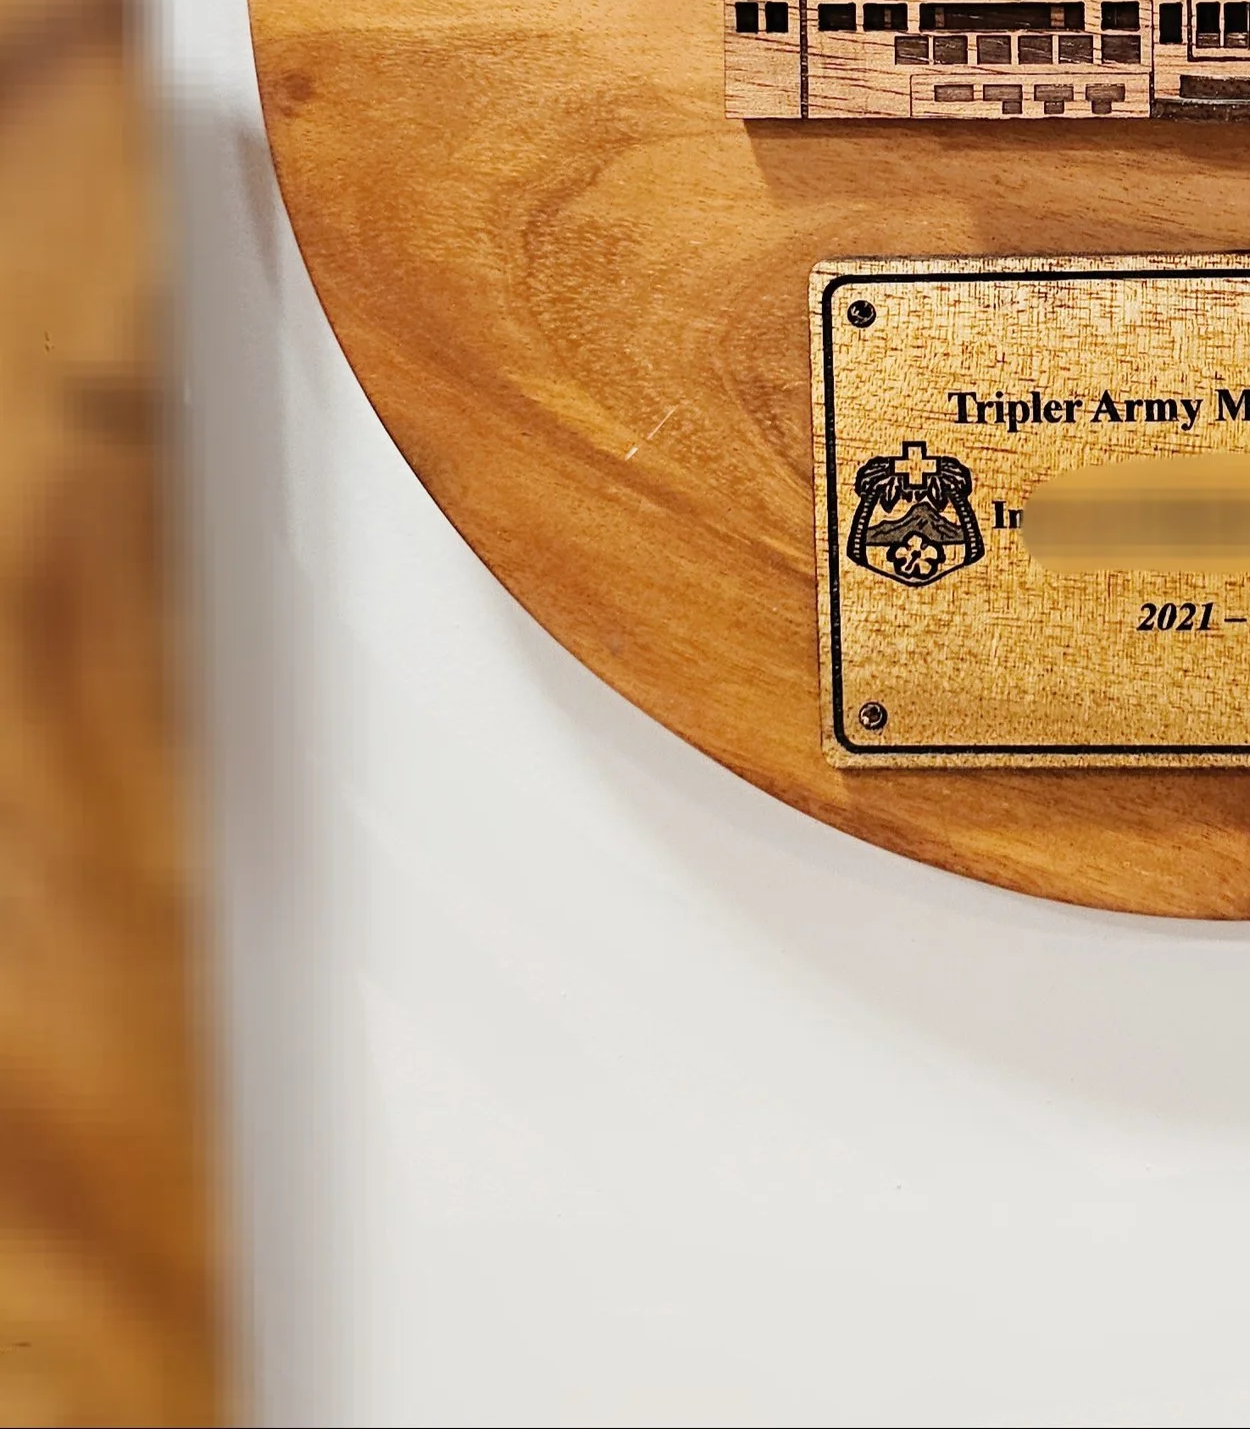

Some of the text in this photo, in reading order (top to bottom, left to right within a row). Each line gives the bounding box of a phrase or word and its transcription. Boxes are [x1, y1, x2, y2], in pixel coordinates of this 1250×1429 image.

[947, 390, 1083, 433] Tripler
[1091, 388, 1203, 431] Army
[1136, 601, 1214, 631] 2021
